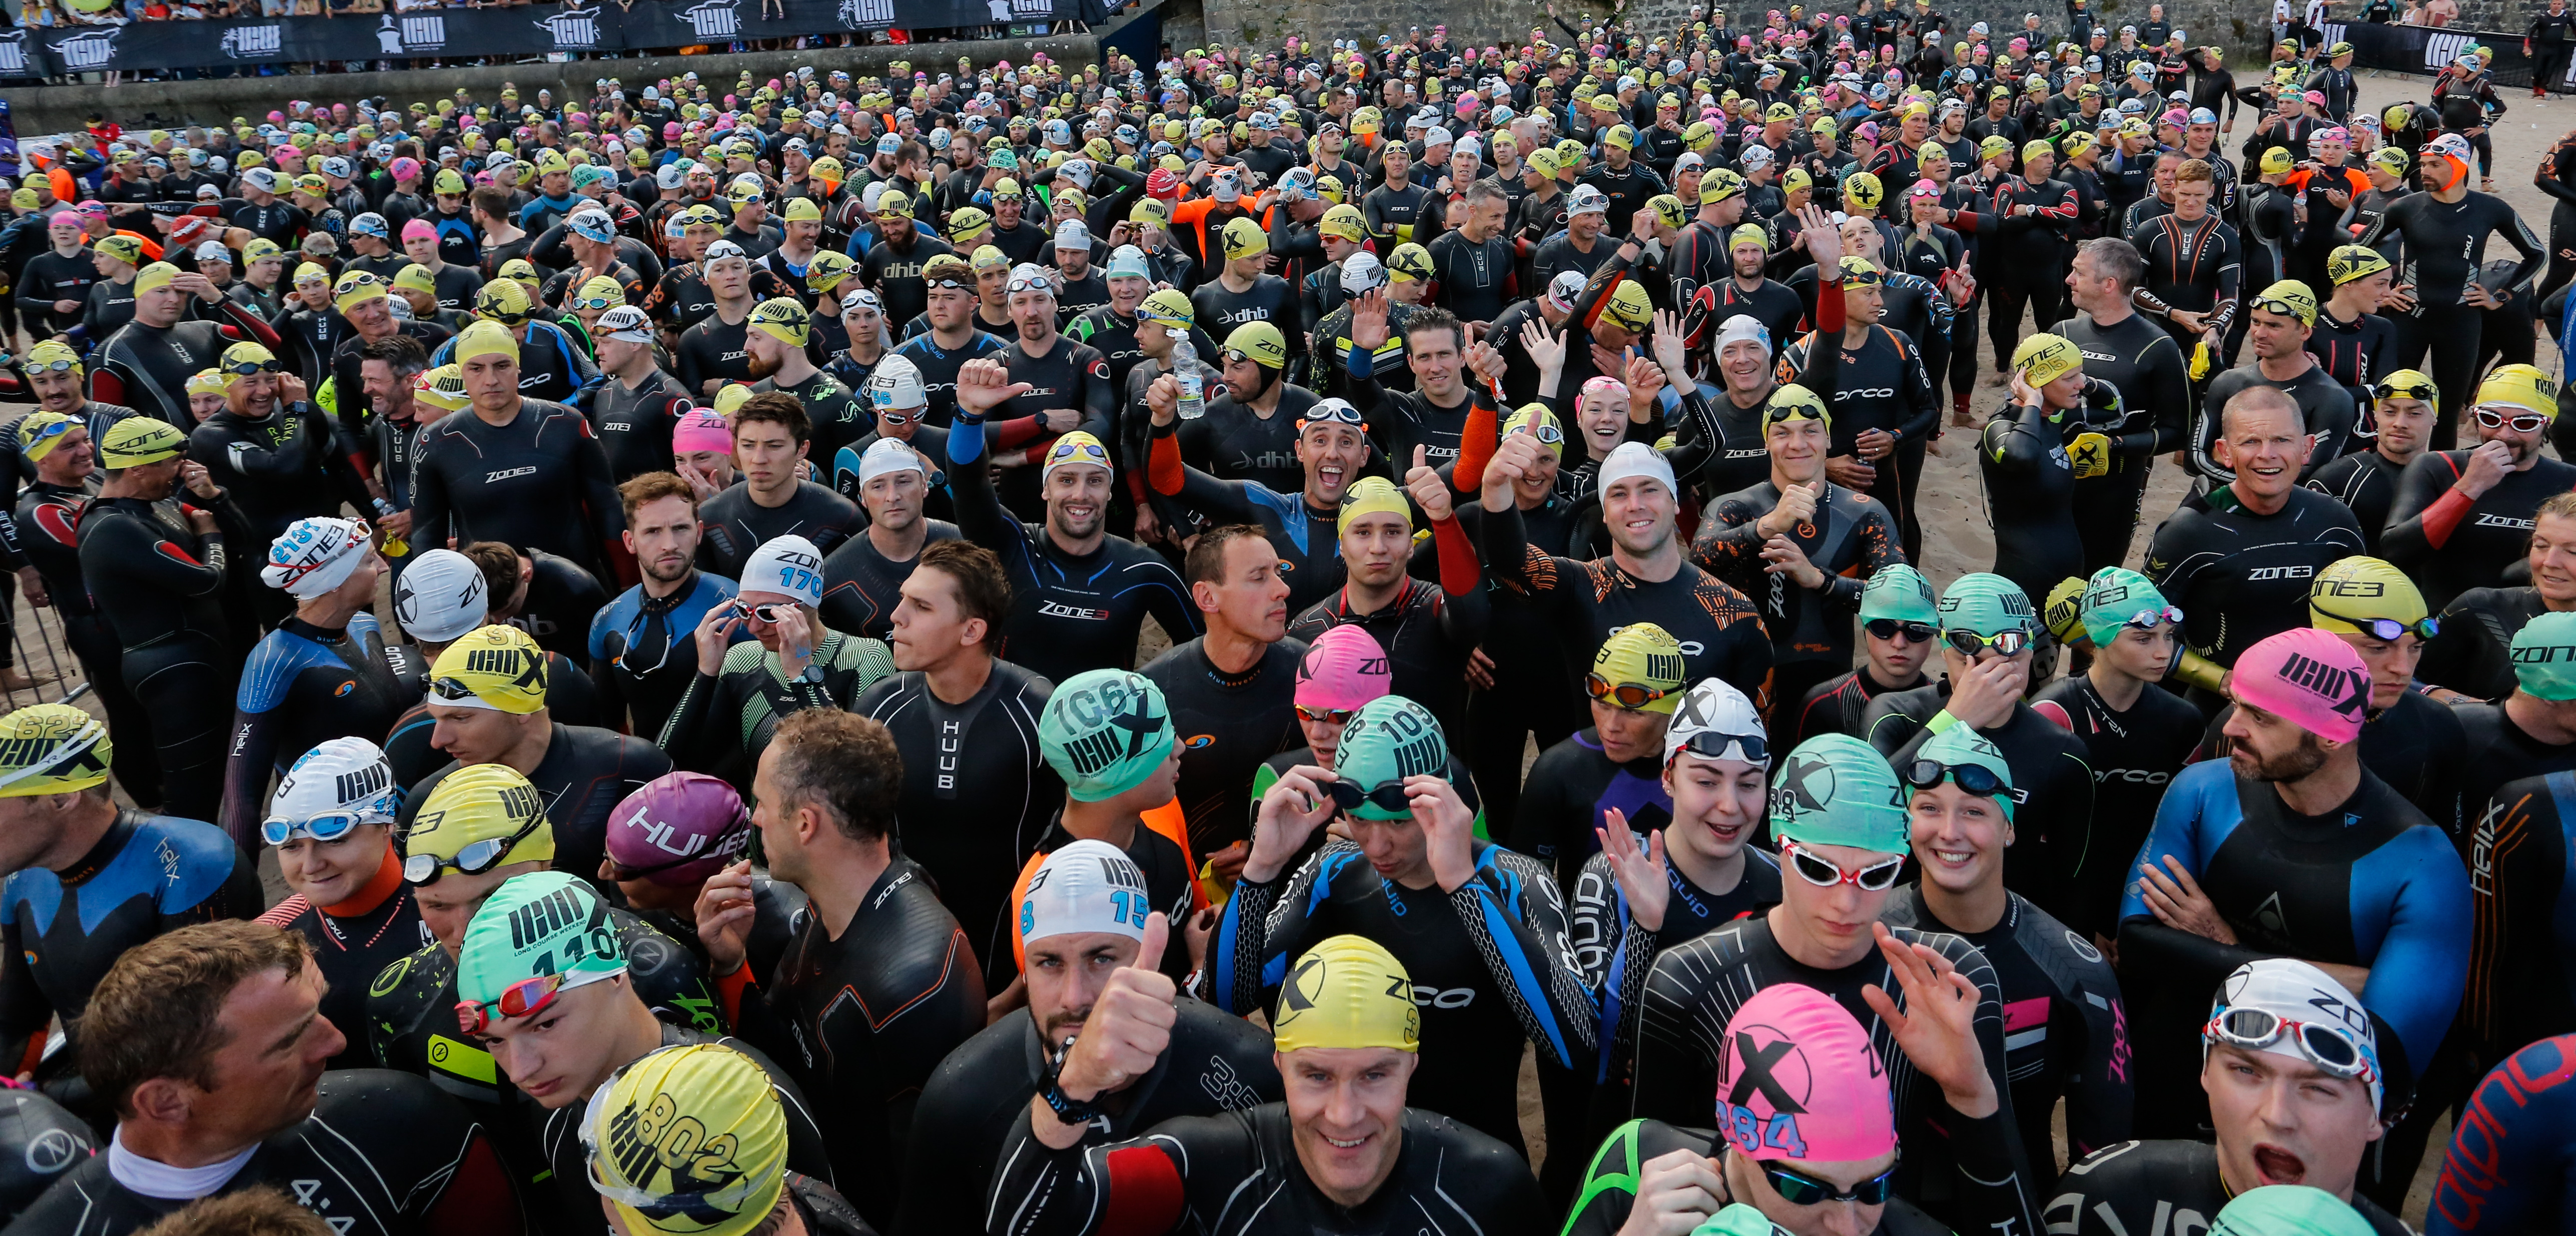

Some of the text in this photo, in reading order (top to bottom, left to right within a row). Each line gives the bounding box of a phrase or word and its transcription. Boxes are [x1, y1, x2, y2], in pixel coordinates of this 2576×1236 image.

[150, 204, 182, 212] HUUB
[2126, 205, 2134, 230] fusion
[2182, 233, 2192, 260] HUUB
[2463, 234, 2473, 260] 2XU
[884, 261, 922, 277] dhb
[1475, 250, 1485, 273] HUUB
[2339, 251, 2378, 272] X
[1058, 303, 1098, 312] orca
[1608, 296, 1641, 314] ONE3
[2141, 291, 2166, 307] HUUB
[1115, 319, 1129, 328] TRN
[1235, 307, 1268, 321] dhb
[2219, 304, 2233, 322] HUUB
[2320, 314, 2338, 328] 2XU
[318, 317, 328, 340] HUUB
[721, 351, 748, 361] ZONE
[927, 337, 945, 360] equip
[2016, 343, 2066, 371] ZONE3
[2081, 350, 2116, 361] ZONE3
[1908, 343, 1931, 388] orca
[2360, 353, 2369, 386] 2XU
[1021, 387, 1056, 396] ZONE3
[1834, 387, 1895, 401] orca
[604, 422, 631, 432] ZONE3
[112, 426, 181, 454] ZONE3
[394, 428, 402, 463] HUUB
[1426, 445, 1461, 457] ZONE
[1725, 448, 1768, 459] ZONE3
[485, 466, 537, 484] ZONE3
[2475, 514, 2534, 528] ZONE
[277, 523, 347, 585] ZONE3
[776, 550, 823, 573] ZON
[2247, 565, 2312, 580] ZONE3
[1038, 600, 1109, 621] ZONE3
[2512, 646, 2575, 663] ZON
[512, 648, 547, 689] X
[1208, 668, 1262, 687] blueseventy
[2289, 680, 2312, 692] COURSE
[2311, 690, 2337, 704] WEEKEND
[2329, 667, 2373, 713] X
[1671, 690, 1710, 729] X
[1108, 688, 1166, 763] X
[2100, 712, 2126, 738] TRN
[231, 723, 252, 756] helix
[937, 720, 960, 790] HUUB
[1772, 756, 1831, 811] X
[2094, 767, 2170, 784] orca
[626, 805, 751, 860] HUUB
[2469, 796, 2505, 896] helix
[153, 836, 181, 887] helix
[874, 871, 913, 909] ZONE3
[327, 918, 347, 940] 2XU
[1536, 874, 1584, 977] orca
[514, 919, 587, 957] LONG COURSE WEEKEND
[1276, 960, 1324, 1024] X
[1727, 1031, 1809, 1115] X
[635, 1092, 738, 1183] 802
